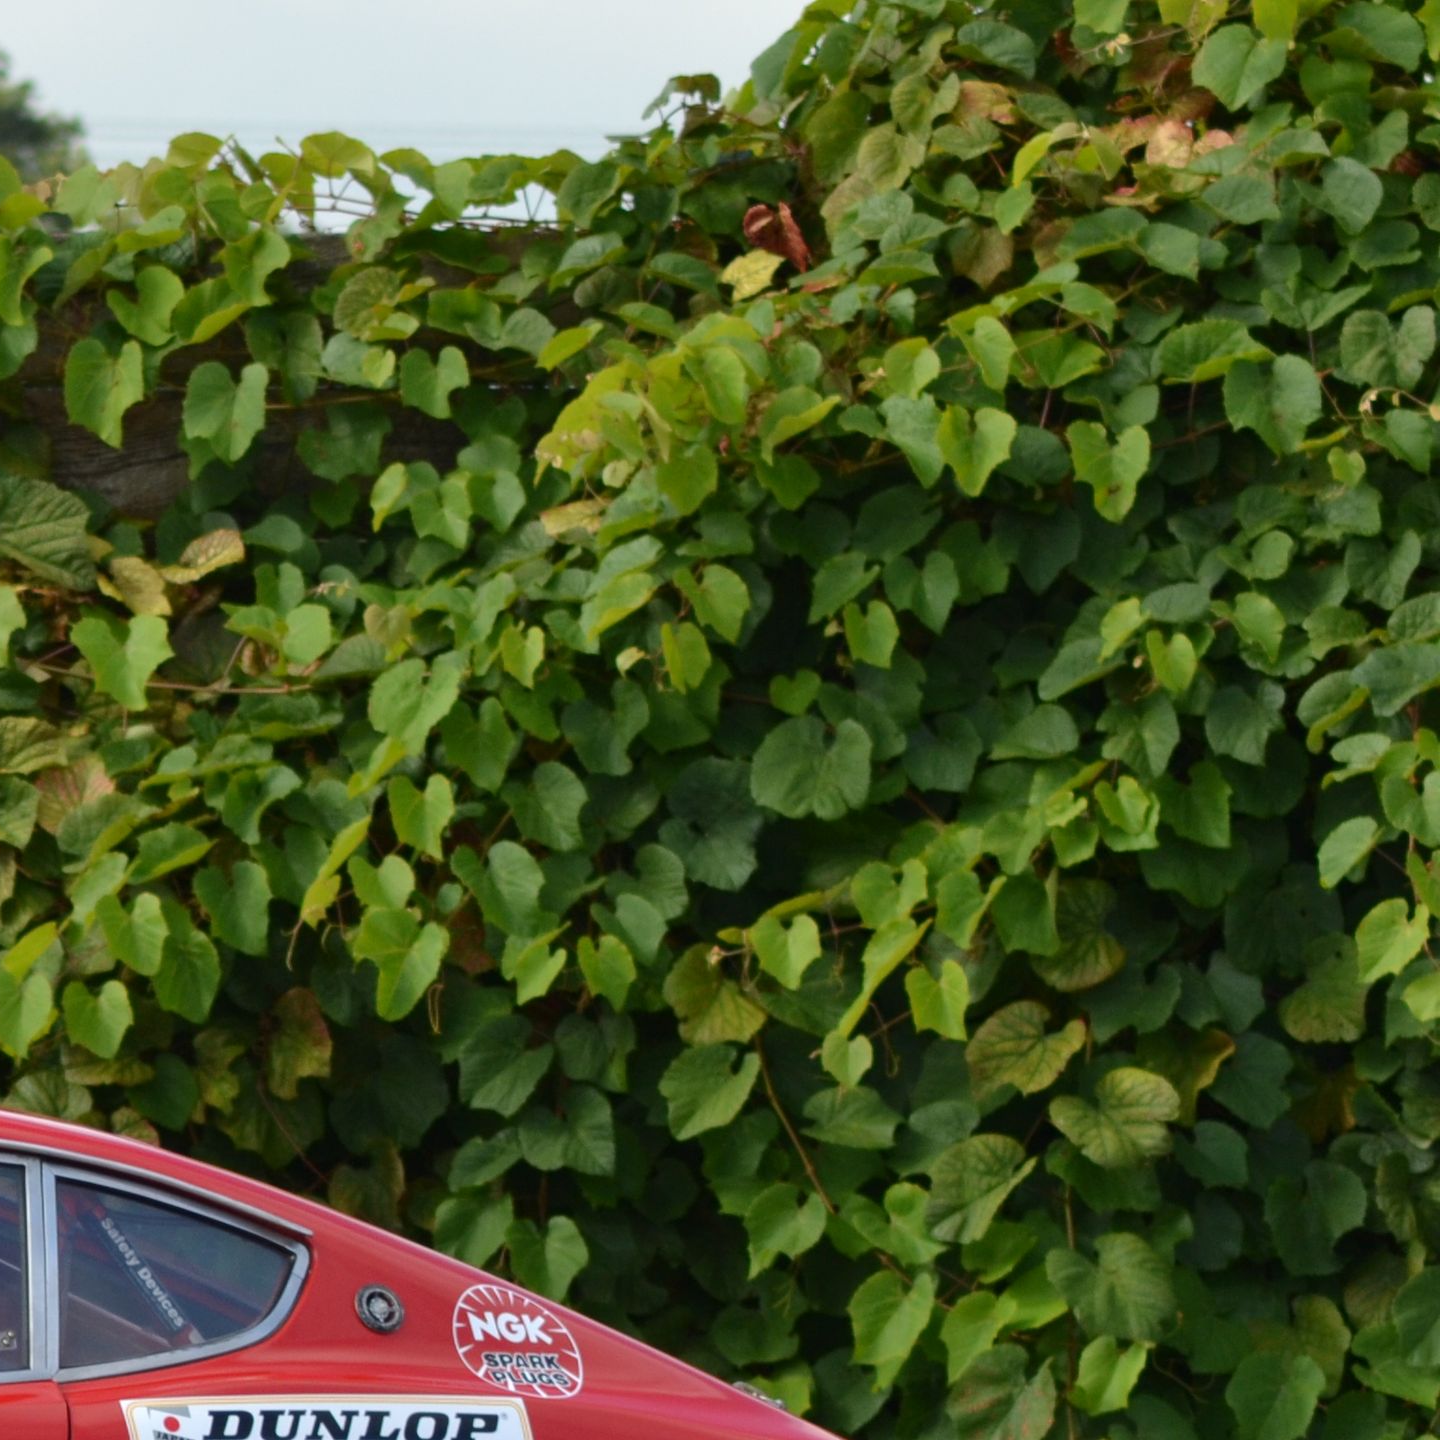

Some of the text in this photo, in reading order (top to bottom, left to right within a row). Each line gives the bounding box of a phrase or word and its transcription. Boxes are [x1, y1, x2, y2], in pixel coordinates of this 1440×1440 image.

[101, 1218, 184, 1327] Safety Devices
[466, 1310, 554, 1345] NGK
[481, 1352, 561, 1370] SPARK
[489, 1370, 572, 1388] PLUGS
